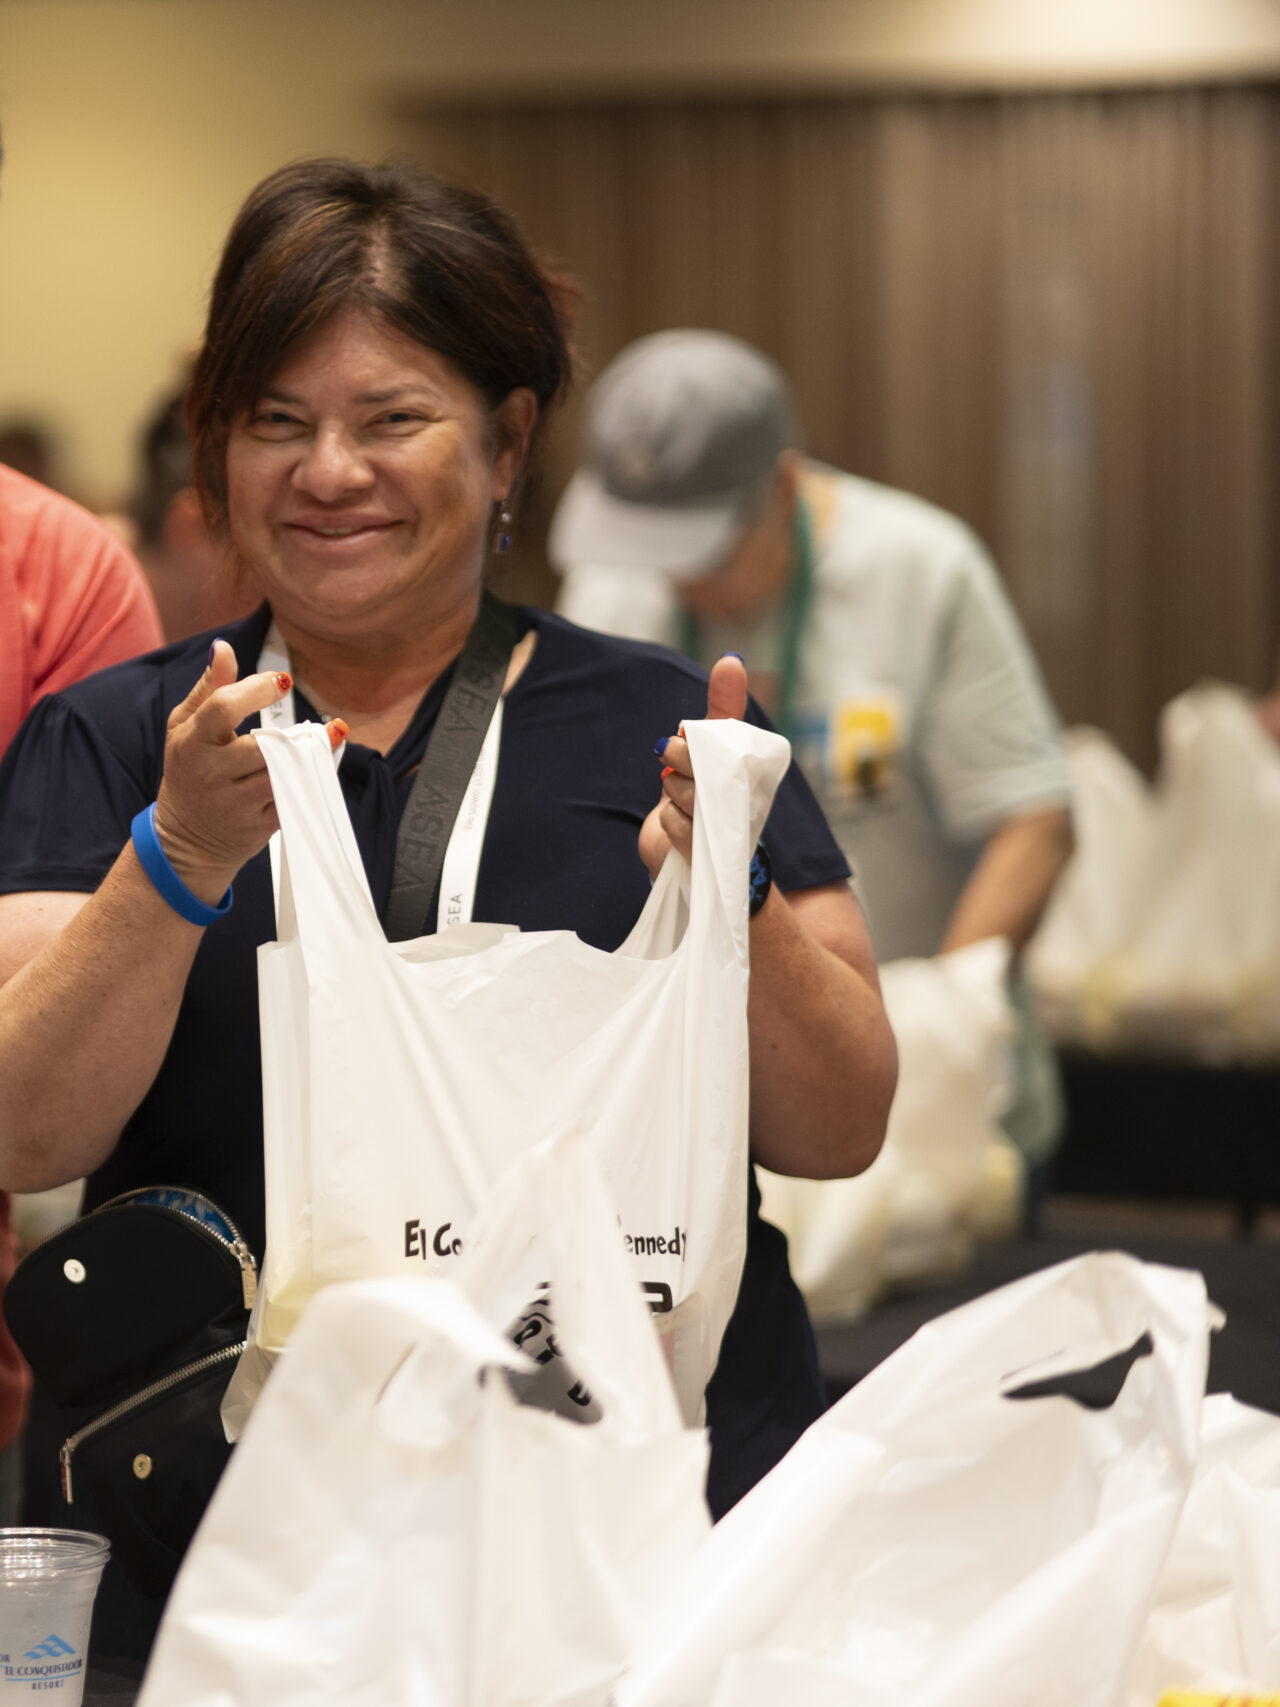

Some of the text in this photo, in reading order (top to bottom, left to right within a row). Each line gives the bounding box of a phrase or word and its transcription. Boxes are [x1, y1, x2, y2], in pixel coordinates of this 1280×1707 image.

[404, 1218, 427, 1260] El
[621, 1223, 688, 1262] ennedy
[16, 1658, 83, 1677] CONQUISTADOR
[31, 1679, 65, 1690] RESORT
